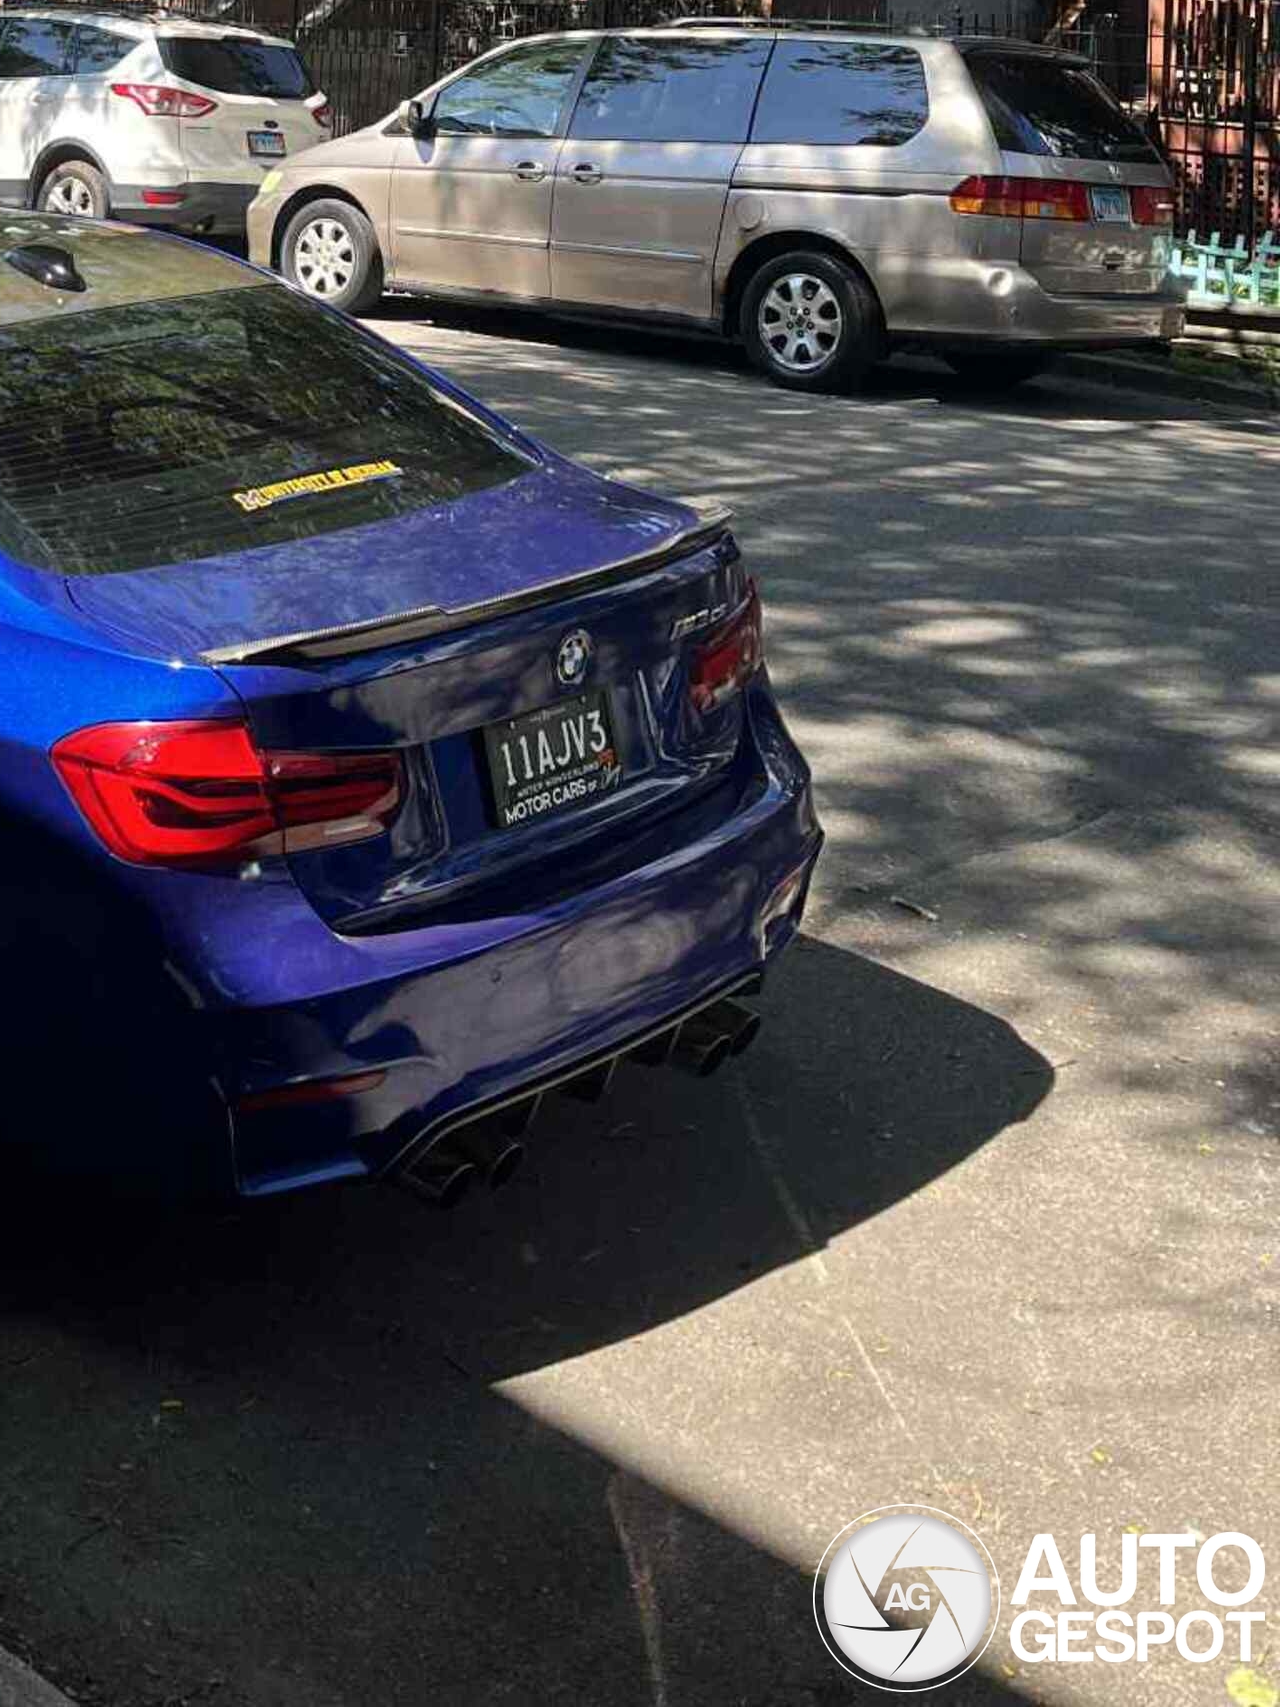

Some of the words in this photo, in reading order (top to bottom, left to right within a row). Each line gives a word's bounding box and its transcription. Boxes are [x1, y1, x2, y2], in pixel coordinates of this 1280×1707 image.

[500, 709, 607, 787] 11AJV3
[504, 792, 552, 825] MOTOR
[552, 778, 587, 805] CARS
